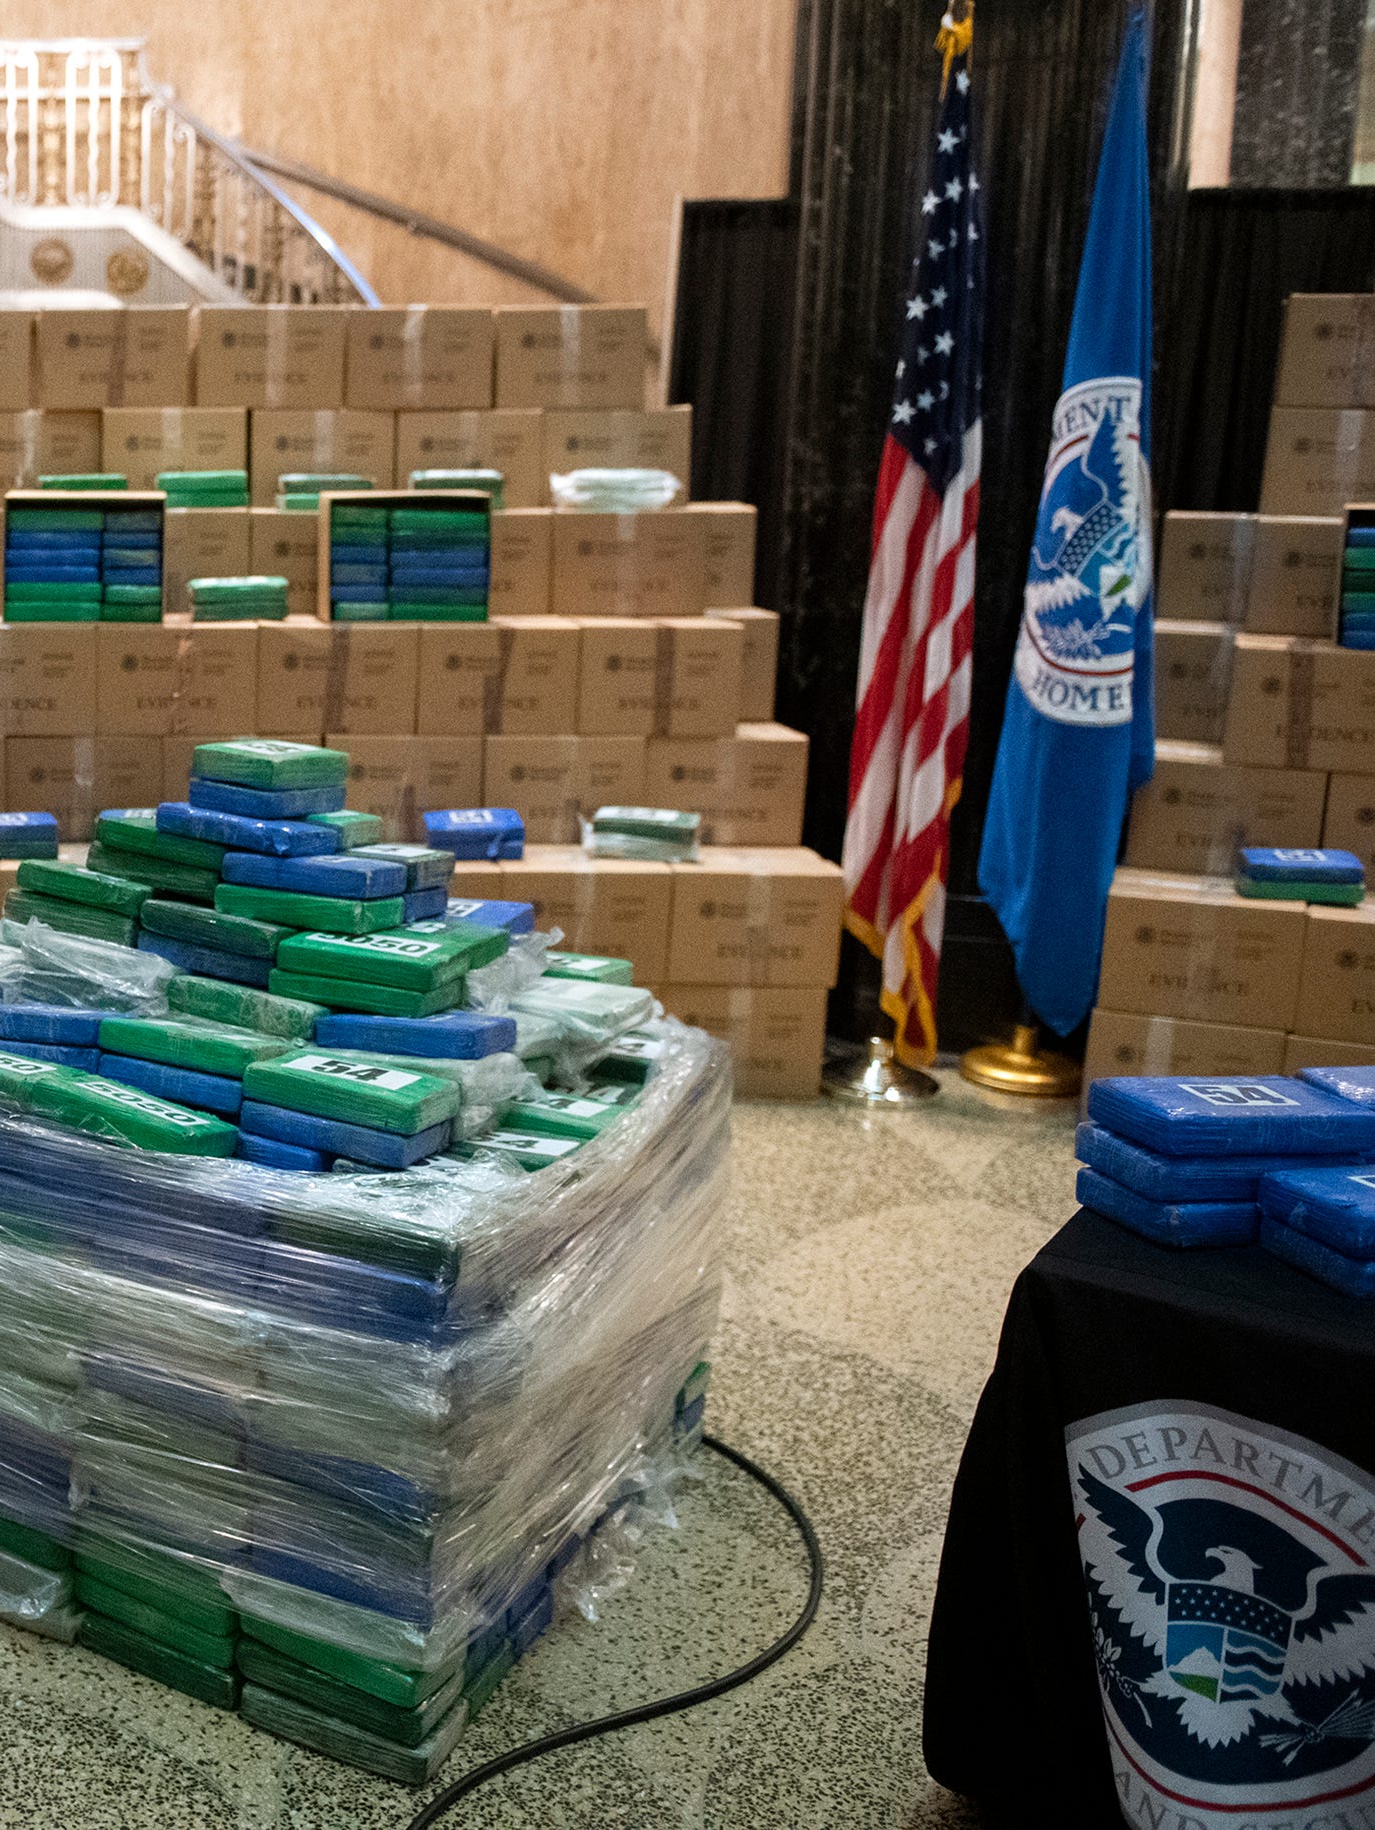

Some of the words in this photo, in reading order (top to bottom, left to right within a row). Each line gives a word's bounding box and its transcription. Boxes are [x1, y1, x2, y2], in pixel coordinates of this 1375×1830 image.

[312, 1059, 389, 1083] 54
[84, 1081, 199, 1124] 5050
[1196, 1085, 1286, 1105] 54
